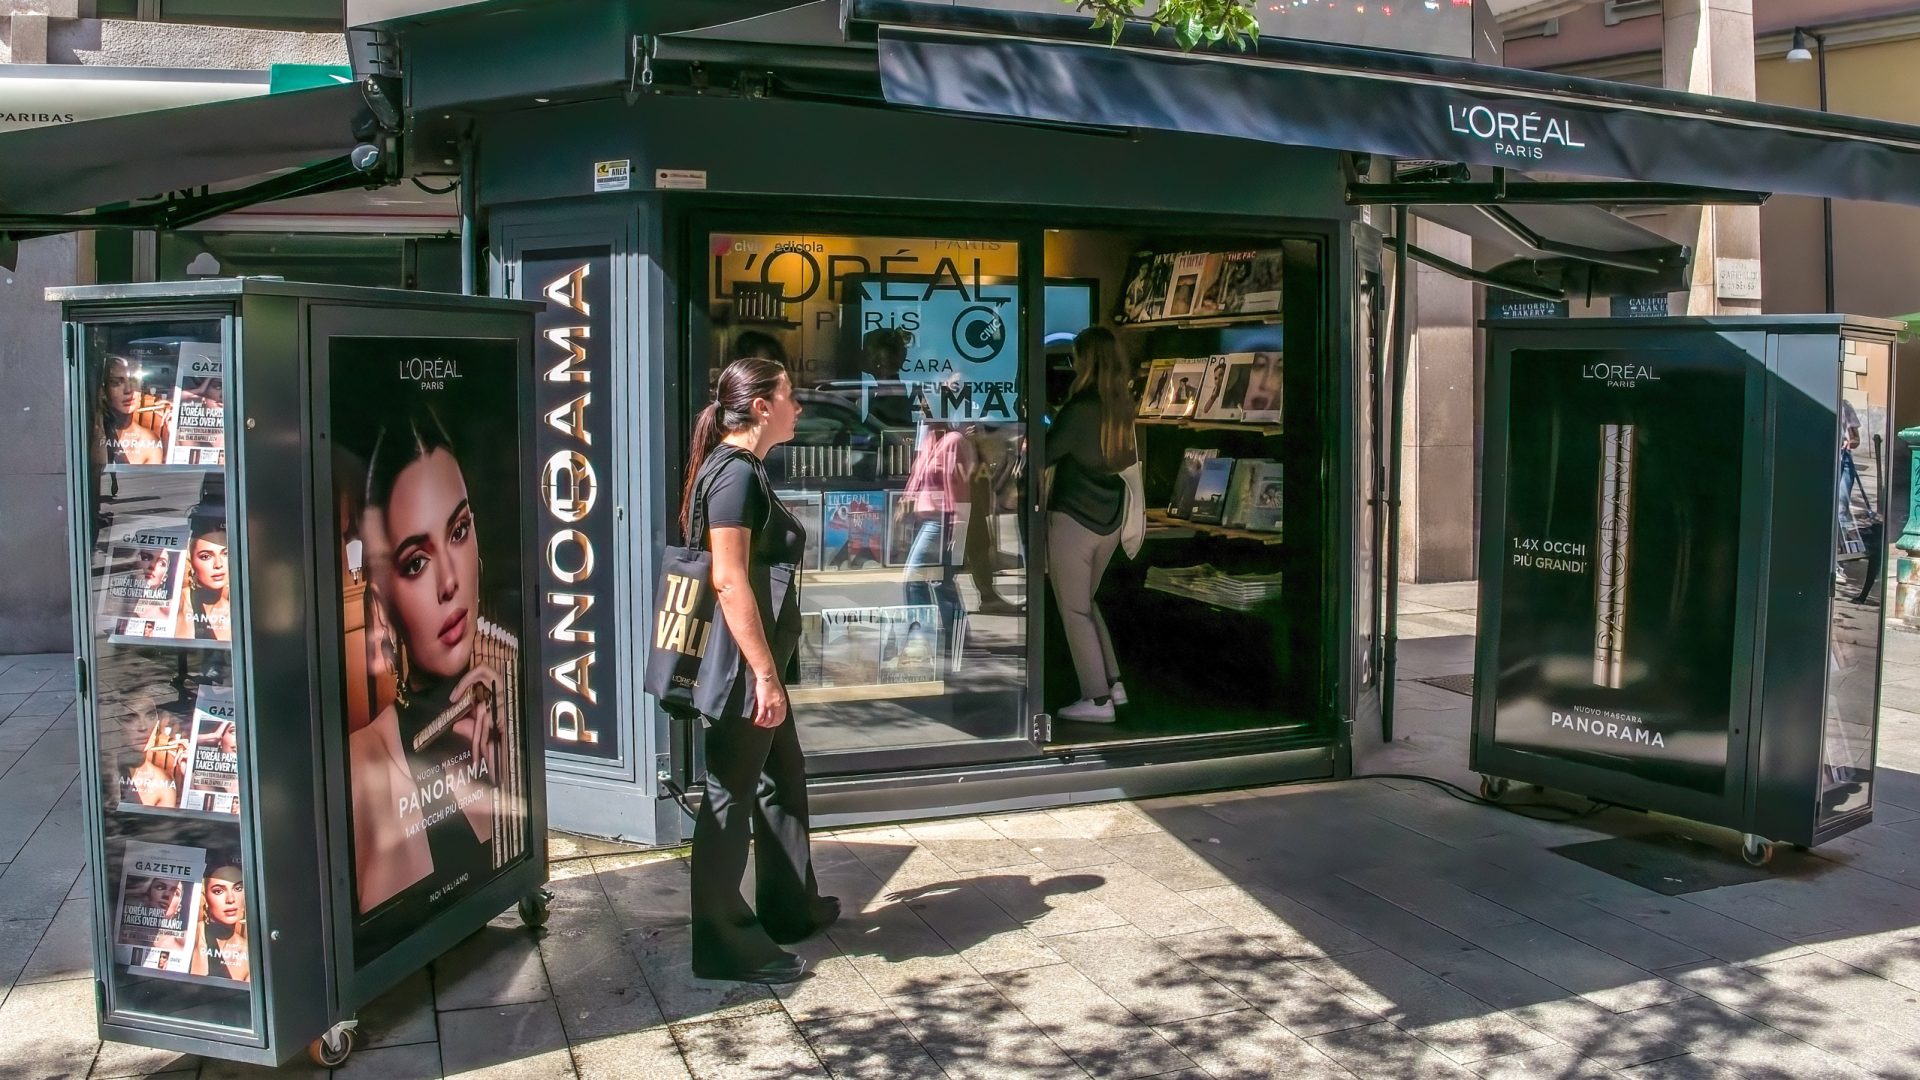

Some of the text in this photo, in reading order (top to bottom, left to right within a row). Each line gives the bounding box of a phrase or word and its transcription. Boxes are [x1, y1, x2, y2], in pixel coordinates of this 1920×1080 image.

[1449, 105, 1585, 147] L'ORÉAL
[715, 247, 1011, 303] L'ORÉAL
[1502, 302, 1555, 311] CALIFORNIA
[1512, 309, 1545, 317] BAKERY
[400, 357, 463, 380] L'ORÉAL
[1583, 363, 1660, 380] L'ORÉAL
[541, 263, 599, 745] PANORAMA
[123, 533, 178, 546] GAZETTE
[1513, 537, 1586, 556] 1.4X OCCHI
[664, 574, 699, 615] TU
[1573, 705, 1642, 724] NUOVO MASCARA
[1551, 711, 1665, 748] PANORAMA
[416, 750, 471, 781] NUOVO MASCARA
[399, 757, 489, 818] PANORAMA
[421, 809, 444, 831] OCCHI
[135, 861, 191, 876] GAZETTE
[442, 872, 469, 896] VALIAMO
